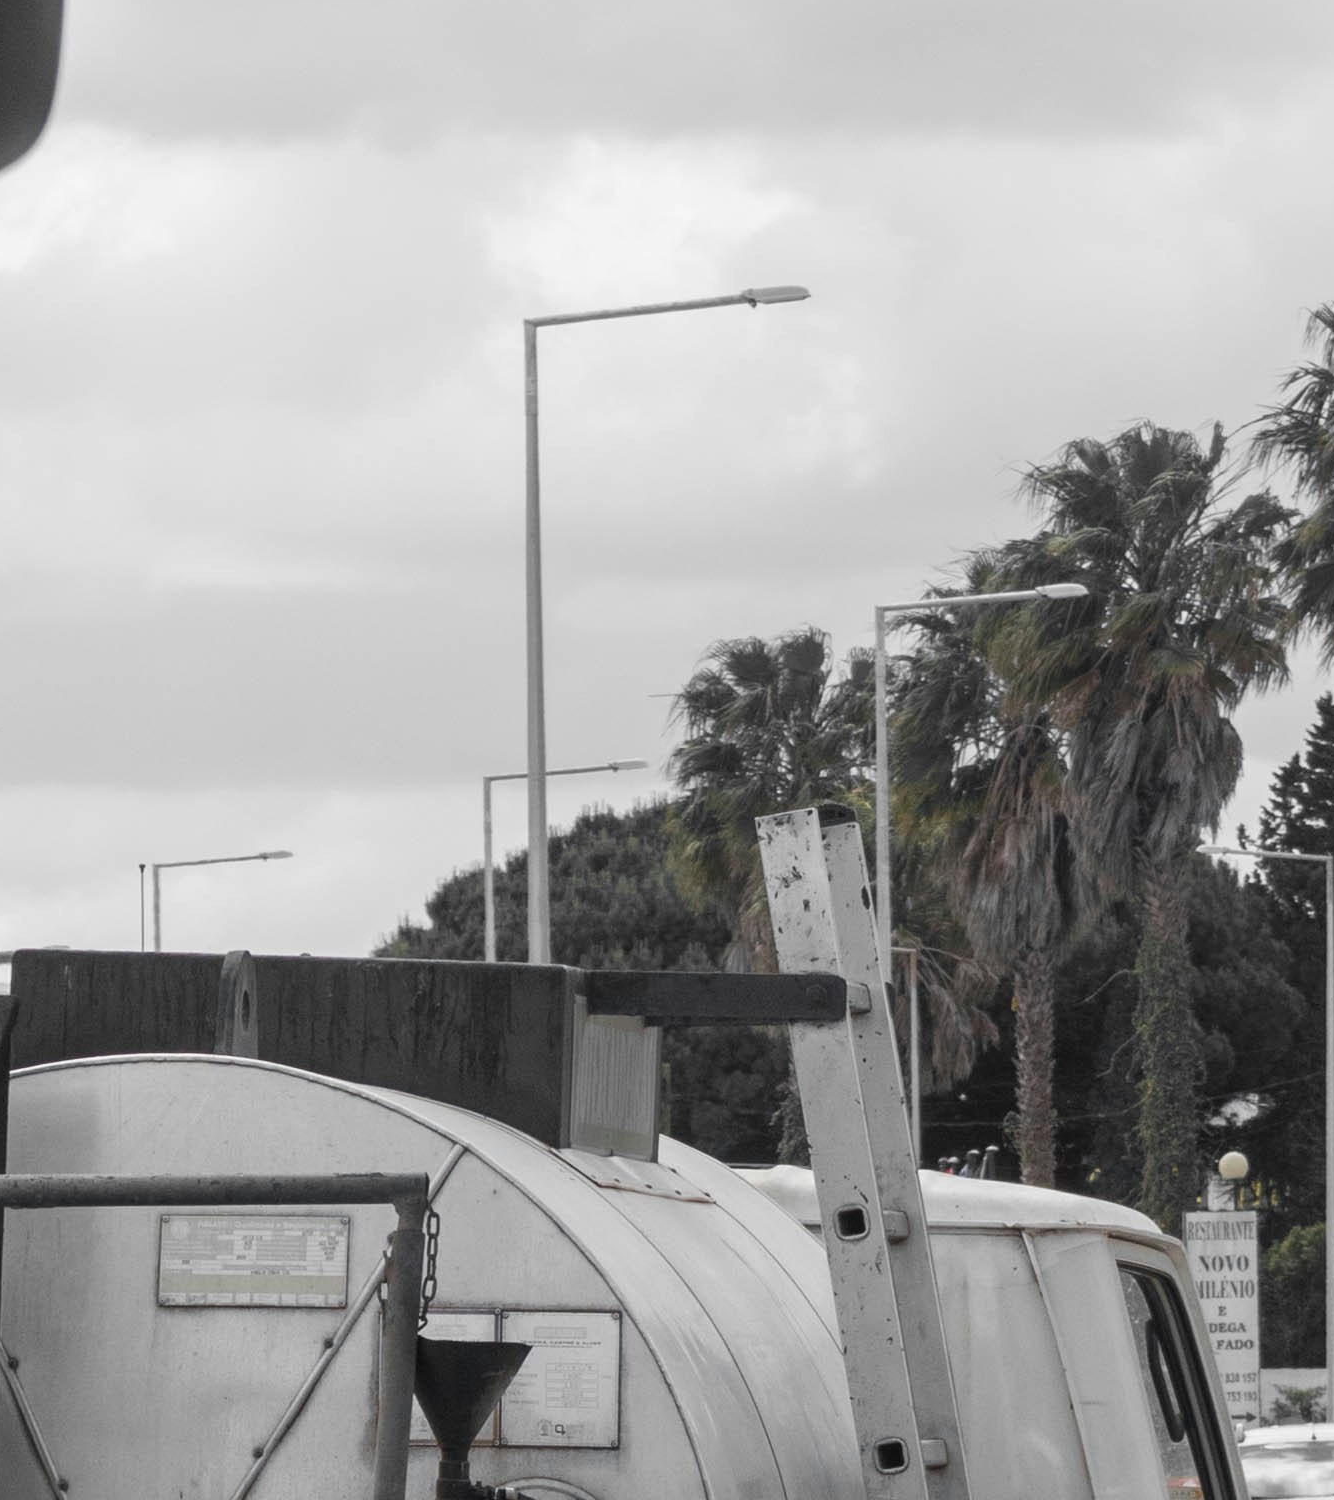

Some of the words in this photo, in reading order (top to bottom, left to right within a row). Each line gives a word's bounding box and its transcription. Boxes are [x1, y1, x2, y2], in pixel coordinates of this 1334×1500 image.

[1188, 1221, 1254, 1241] RESTAURANTE
[1199, 1255, 1250, 1271] NOVO
[1218, 1306, 1227, 1316] E
[1209, 1322, 1247, 1333] DEGA
[1216, 1339, 1254, 1350] FADO
